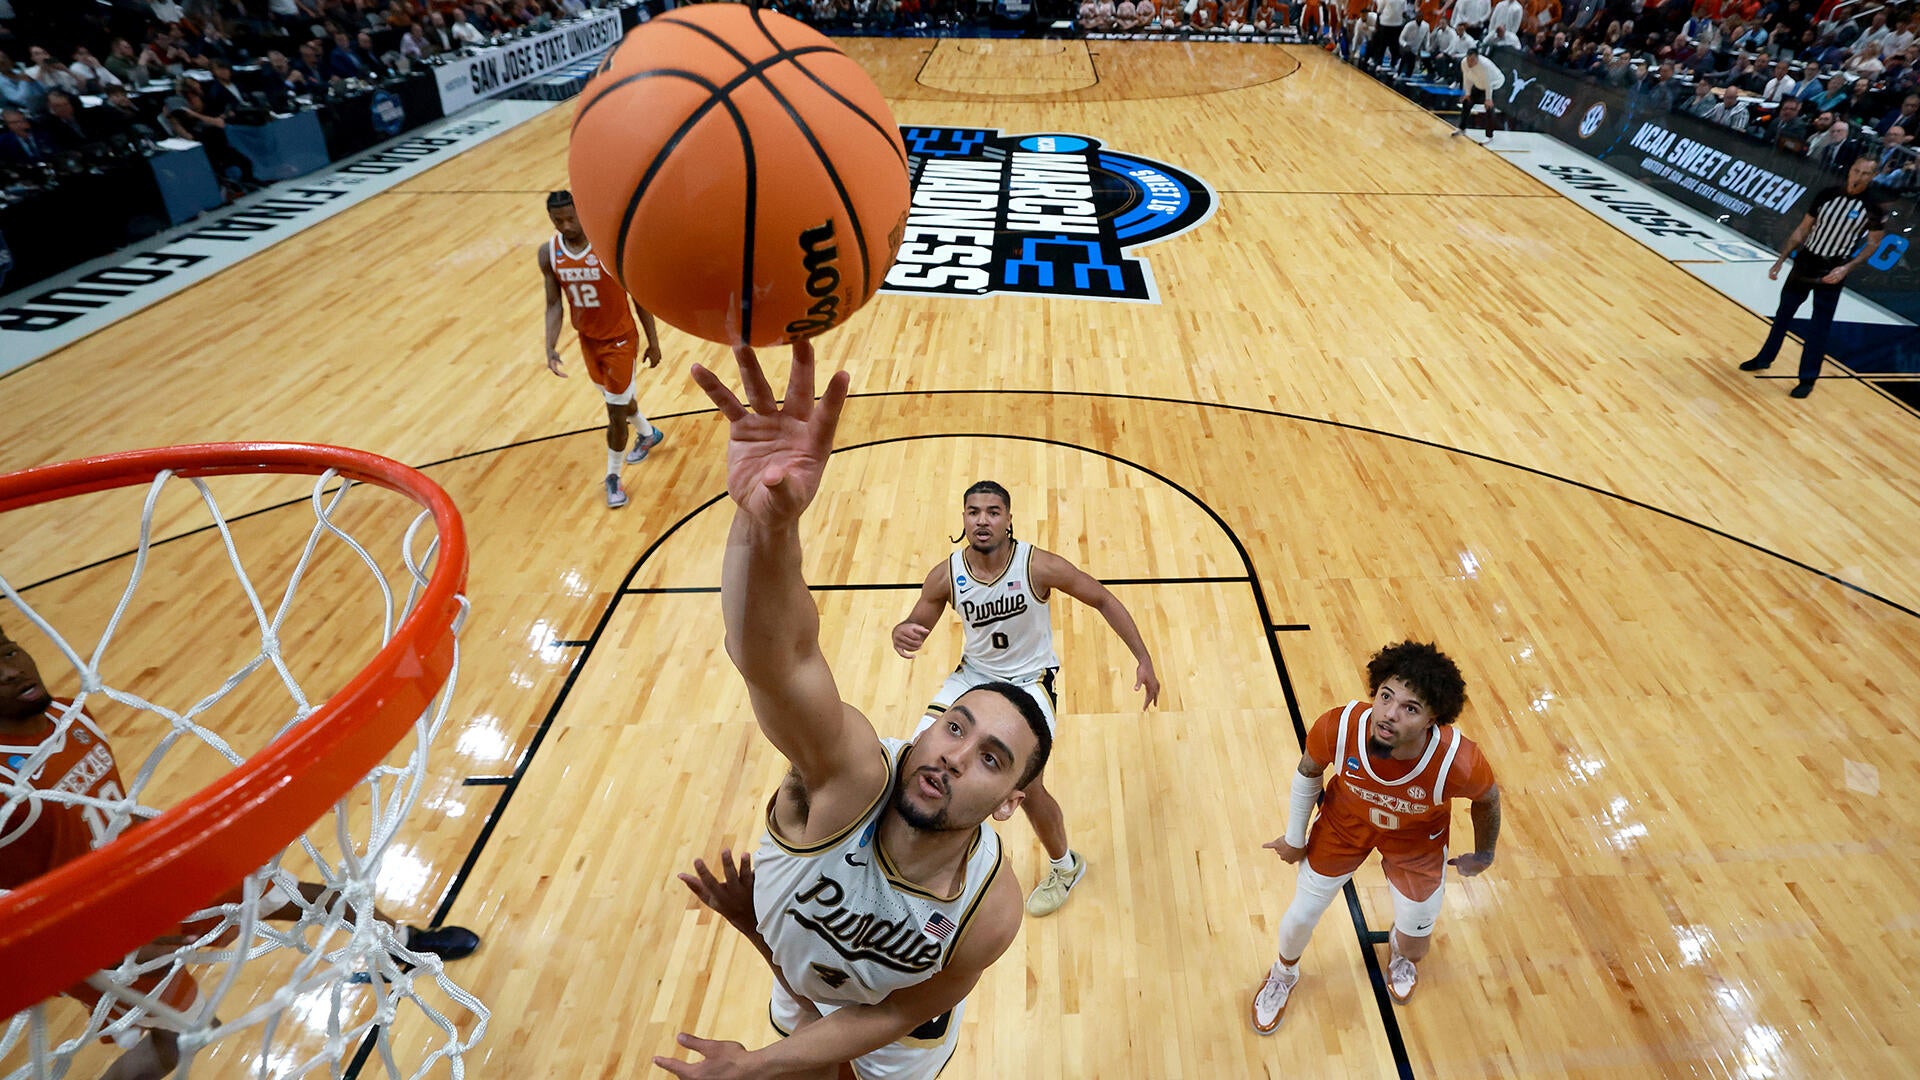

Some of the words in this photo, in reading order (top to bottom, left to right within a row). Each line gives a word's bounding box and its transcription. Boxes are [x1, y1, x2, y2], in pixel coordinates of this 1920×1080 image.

[470, 57, 500, 95] SAN
[502, 45, 535, 83] JOSE
[535, 33, 568, 71] STATE
[566, 15, 620, 58] UNIVERSITY
[1538, 89, 1572, 118] TEXAS
[335, 137, 461, 175] ROAD
[1629, 122, 1678, 159] NCAA
[1666, 137, 1732, 181] SWEET
[1718, 160, 1808, 215] SIXTEEN
[1006, 151, 1100, 234] MARCH
[1129, 169, 1181, 198] SWEET
[1694, 182, 1717, 200] STATE
[1712, 191, 1754, 217] UNIVERSITY
[167, 188, 349, 242] FINAL
[1147, 198, 1181, 214] 16
[1538, 164, 1629, 193] SAN
[1590, 194, 1715, 240] JOSE
[884, 158, 1002, 289] MADNESS
[0, 251, 213, 332] FOUR
[557, 267, 601, 282] TEXAS
[568, 283, 601, 308] 12
[961, 593, 1027, 626] Purdue
[992, 632, 1010, 650] 0
[51, 742, 114, 806] TEXAS
[1344, 780, 1430, 815] TEXAS
[1408, 787, 1426, 799] SEC
[1369, 807, 1400, 831] 0
[789, 872, 943, 971] Purdue
